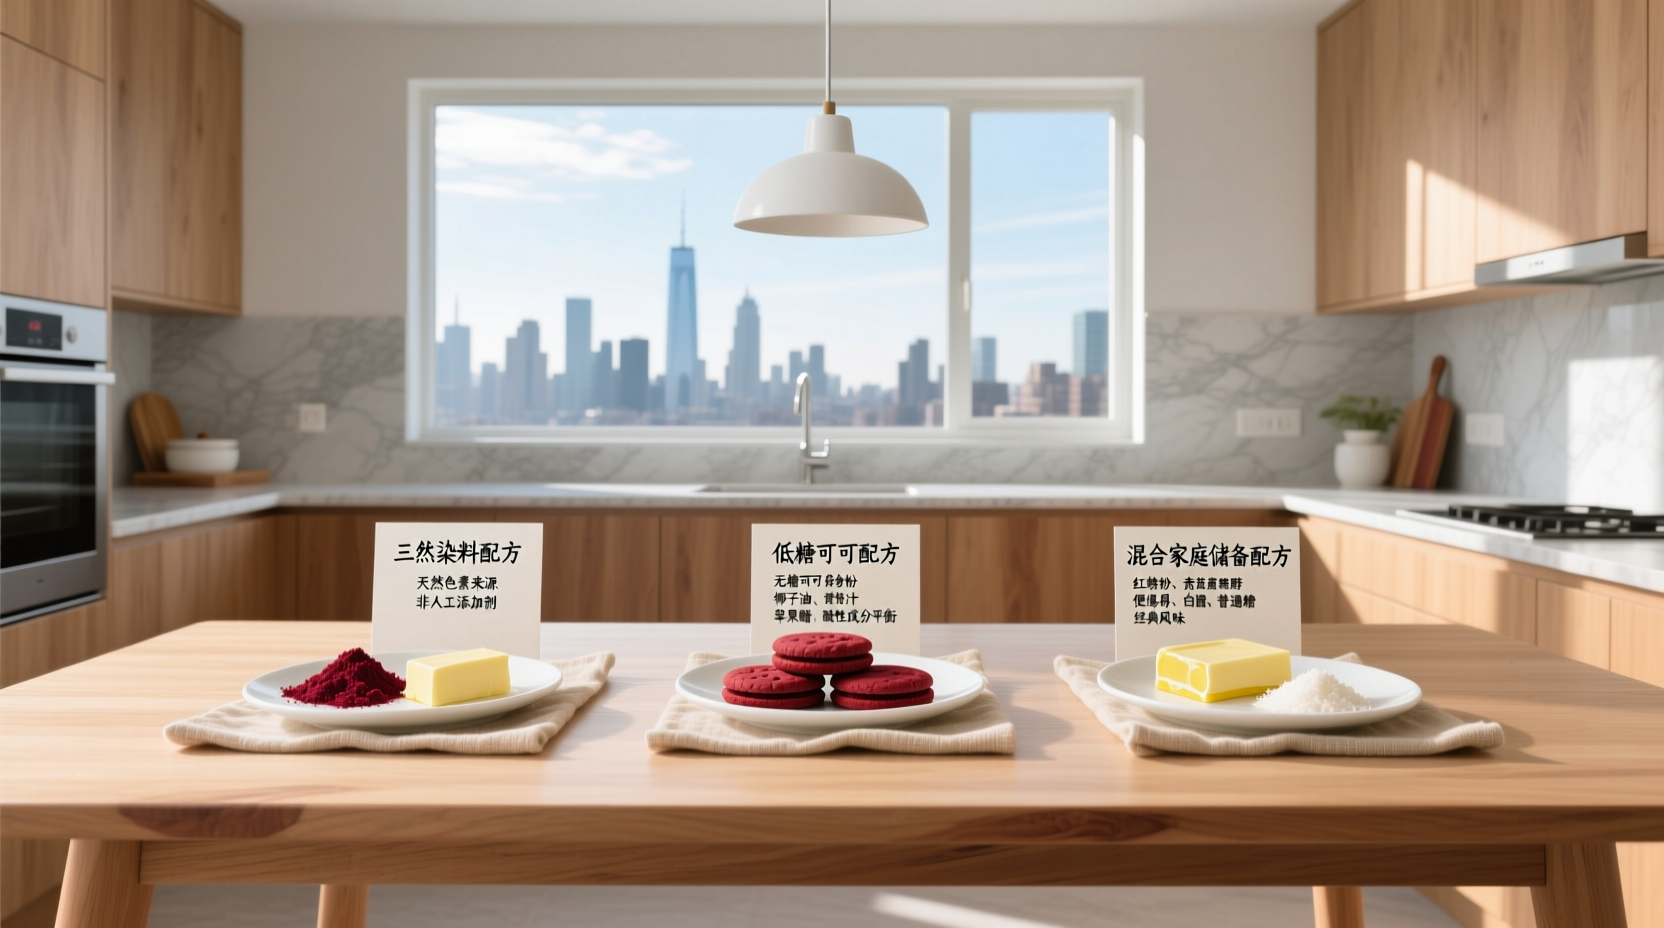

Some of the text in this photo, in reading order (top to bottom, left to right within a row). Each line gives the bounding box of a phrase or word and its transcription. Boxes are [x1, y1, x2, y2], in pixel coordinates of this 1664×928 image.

[393, 539, 522, 565] 三然染料配方
[771, 541, 900, 566] 低糖可可配方
[1126, 542, 1292, 568] 混合家庭储备配方
[416, 593, 498, 610] 非人工添加剂
